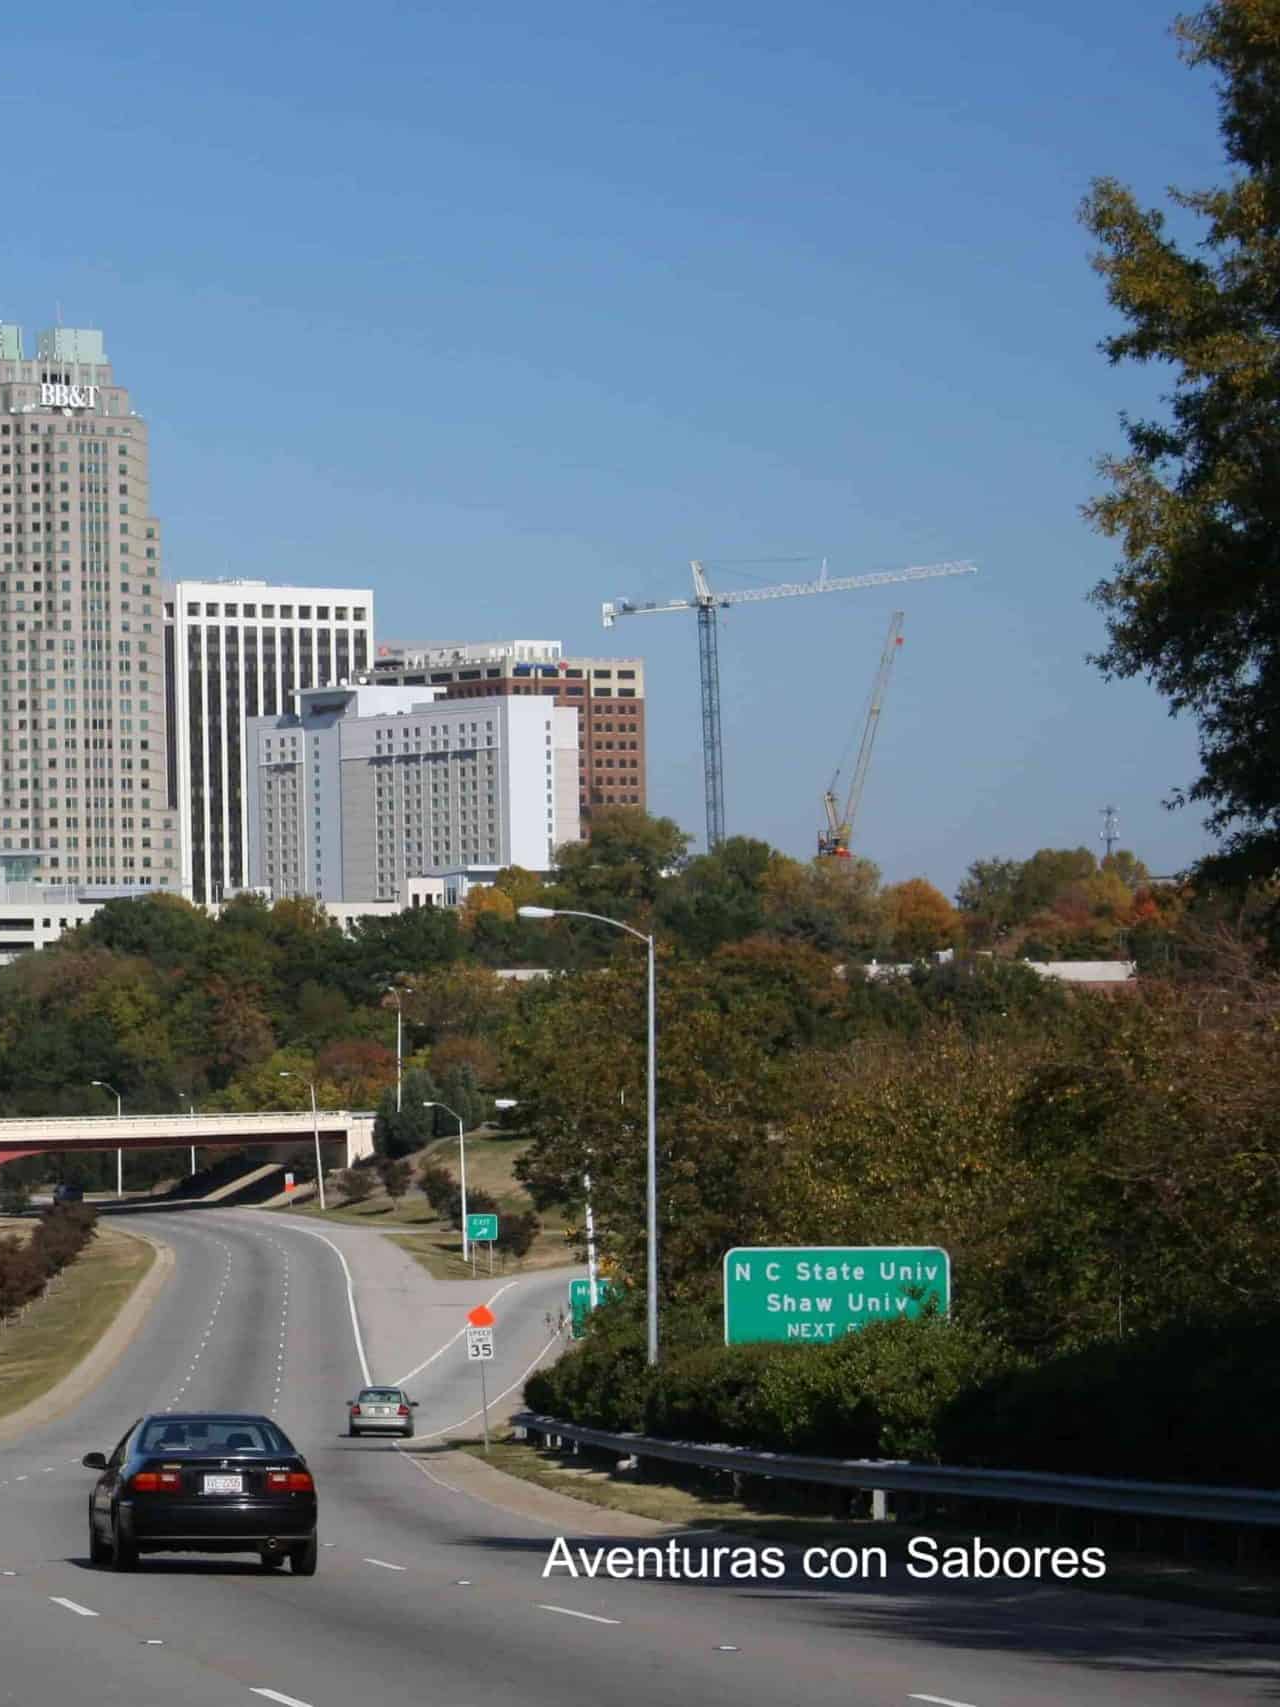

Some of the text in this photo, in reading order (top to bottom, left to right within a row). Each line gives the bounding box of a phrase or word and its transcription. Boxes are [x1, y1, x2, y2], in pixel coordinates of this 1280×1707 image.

[40, 383, 99, 407] BB&T
[735, 1262, 938, 1281] N C State Univ
[767, 1293, 909, 1312] Shaw Univ
[787, 1323, 836, 1338] NEXT
[471, 1343, 492, 1357] 35
